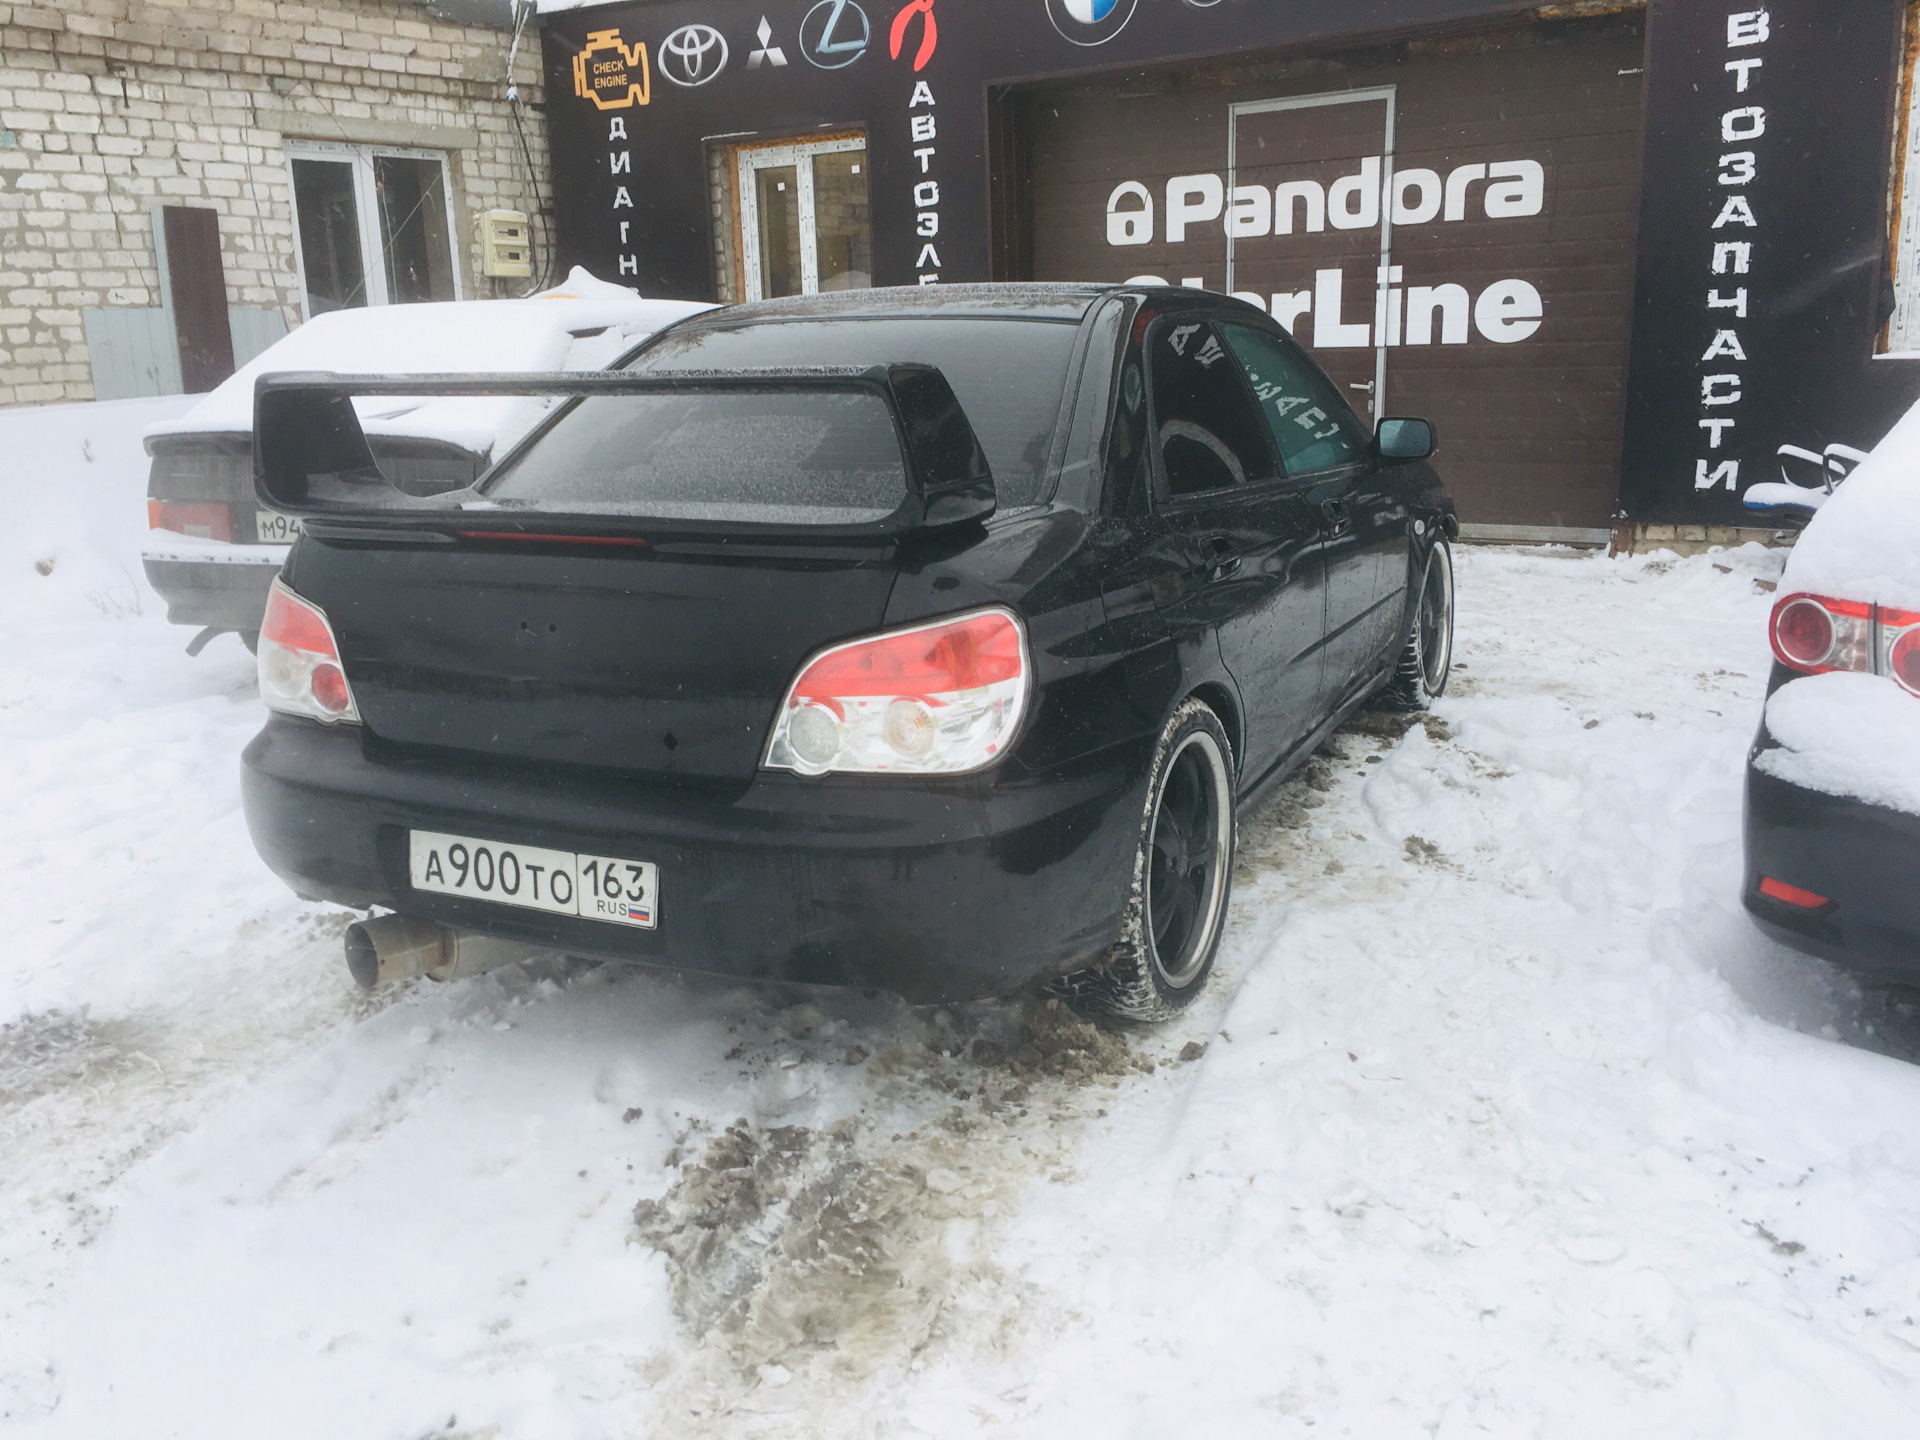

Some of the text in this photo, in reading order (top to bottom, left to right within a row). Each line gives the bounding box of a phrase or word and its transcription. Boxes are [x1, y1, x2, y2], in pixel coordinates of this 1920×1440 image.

[593, 60, 625, 75] CHECK
[594, 74, 628, 89] ENGINE
[609, 116, 640, 294] ДИАГН
[1166, 156, 1545, 243] Pandora
[1123, 266, 1544, 348] rLine
[425, 843, 645, 905] А900ТО 163
[597, 899, 628, 917] RUS
